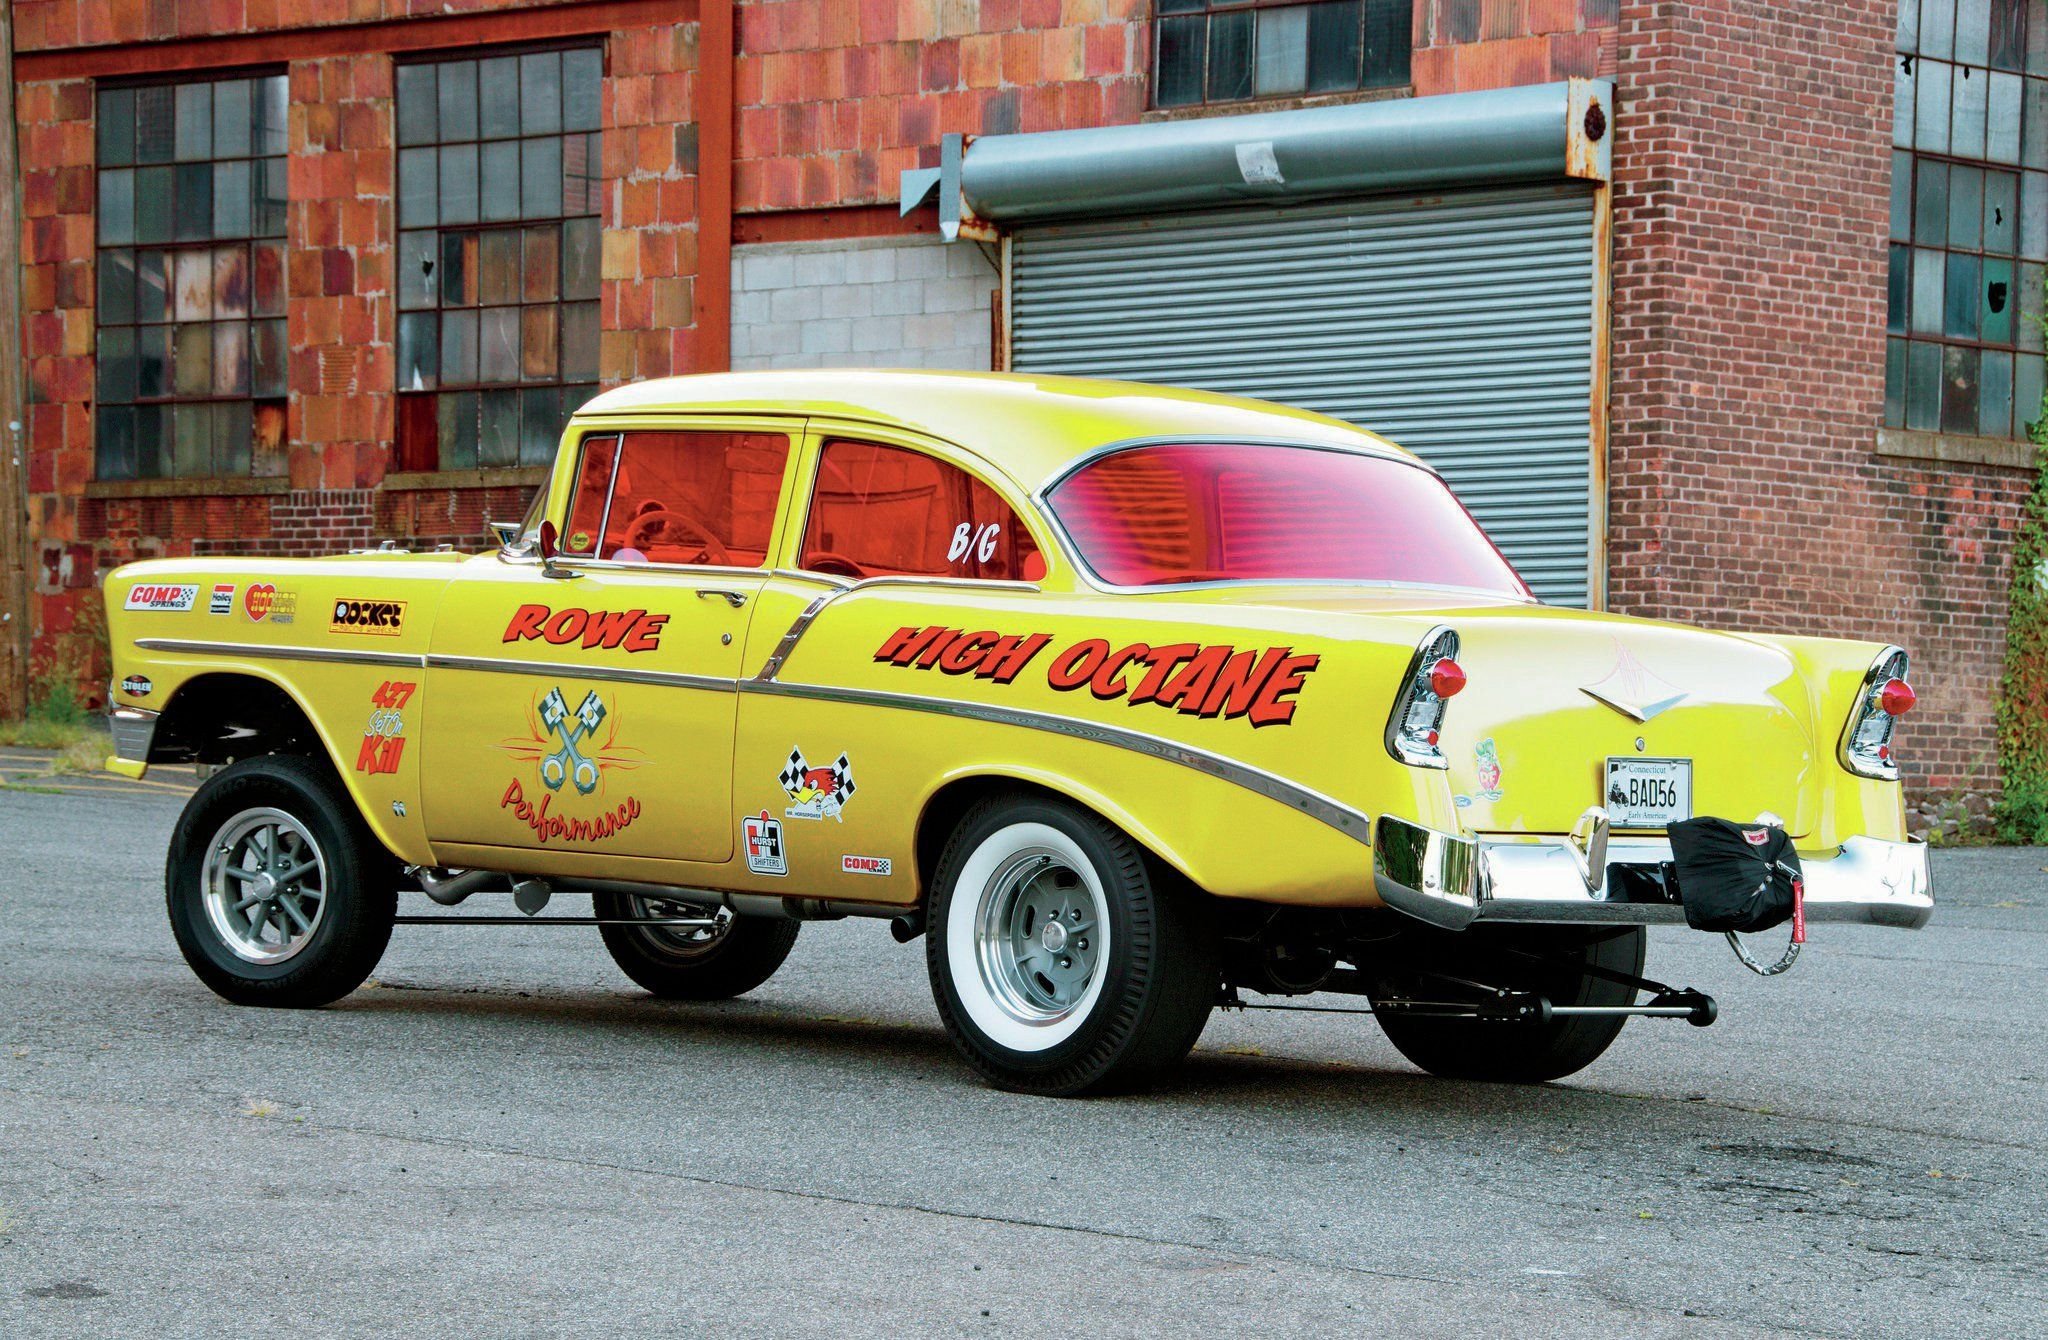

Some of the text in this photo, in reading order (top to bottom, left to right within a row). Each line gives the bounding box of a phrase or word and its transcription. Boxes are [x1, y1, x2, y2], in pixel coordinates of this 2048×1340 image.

[947, 522, 1000, 564] B/G
[131, 586, 181, 603] COMP
[213, 593, 232, 604] Holley
[150, 600, 186, 608] SPRINGS
[502, 604, 671, 653] ROWE
[873, 625, 1320, 729] HIGH OCTANE
[371, 681, 417, 709] 427
[356, 734, 406, 775] Kill
[1628, 764, 1666, 774] Connecticut
[1630, 778, 1676, 807] BAD56
[501, 777, 641, 843] Performance
[1628, 811, 1667, 820] Early American
[751, 836, 777, 847] HURST
[754, 857, 780, 868] SHIFTERS
[844, 857, 879, 870] COMP
